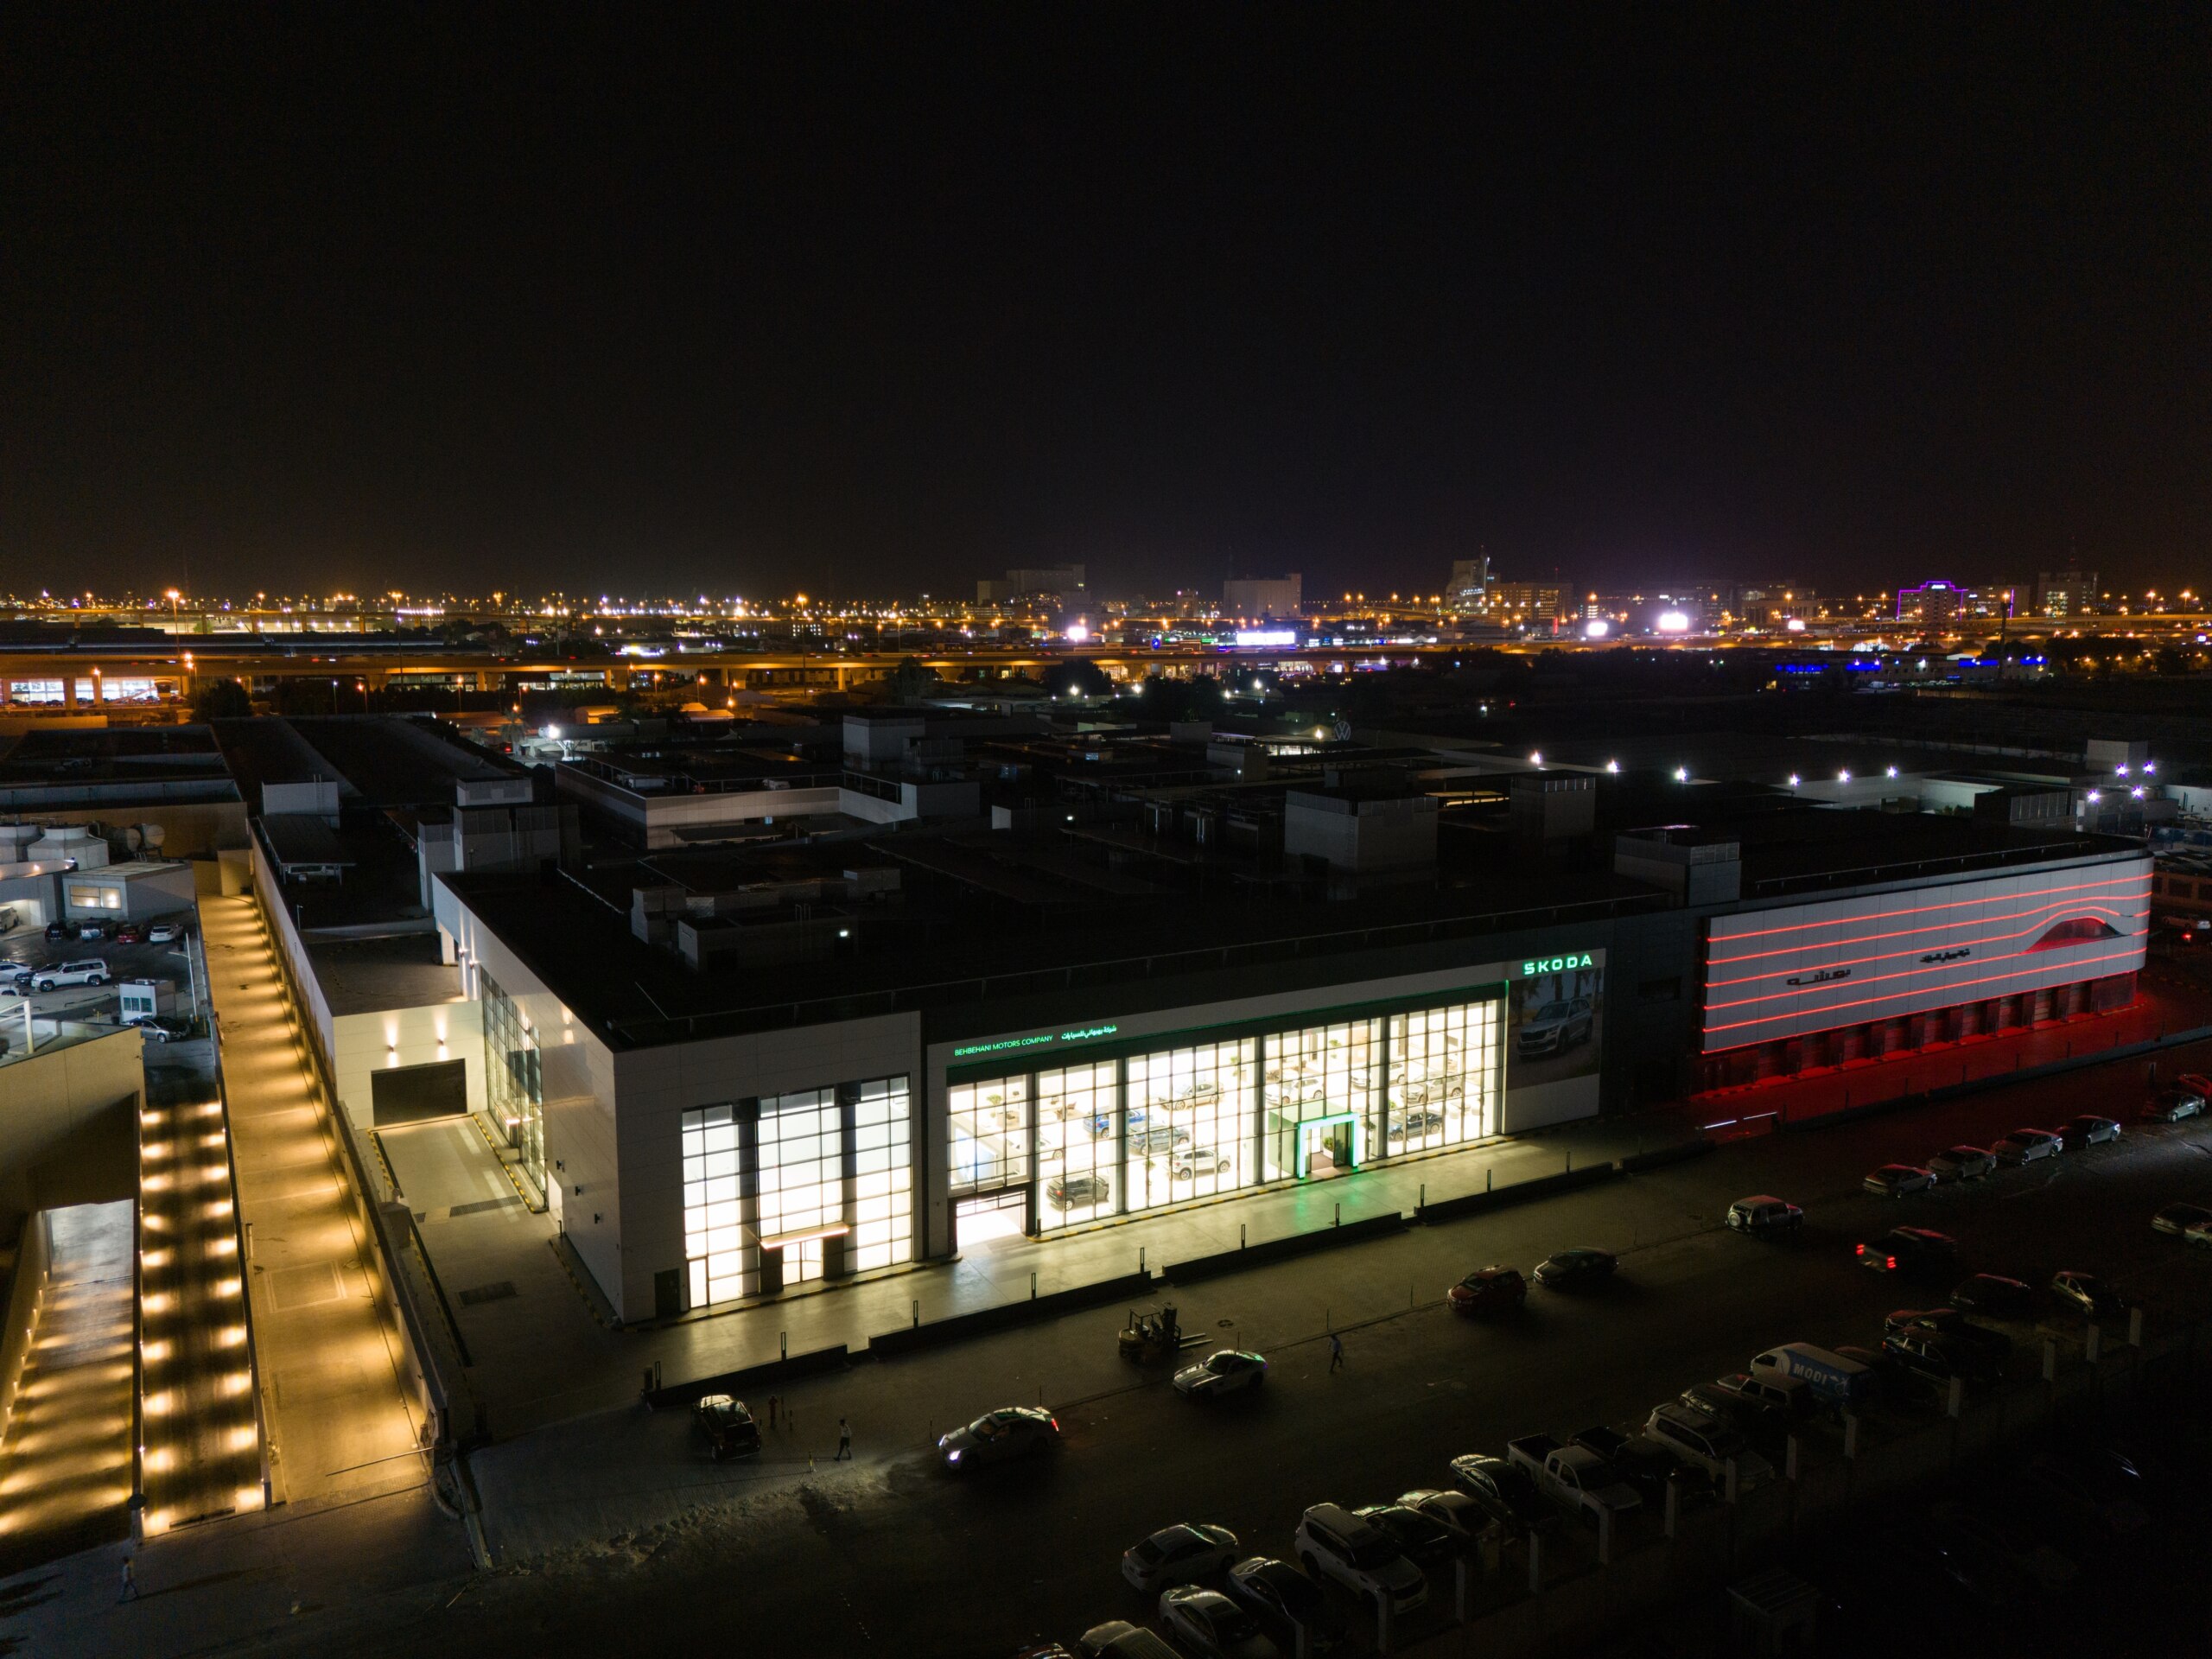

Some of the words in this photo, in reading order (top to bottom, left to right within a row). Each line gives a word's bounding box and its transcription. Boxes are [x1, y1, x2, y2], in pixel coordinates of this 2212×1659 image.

[1524, 955, 1592, 975] SKODA
[955, 1045, 992, 1056] BEHBEHANI
[993, 1039, 1020, 1050] MOTORS
[1021, 1034, 1053, 1046] COMPANY
